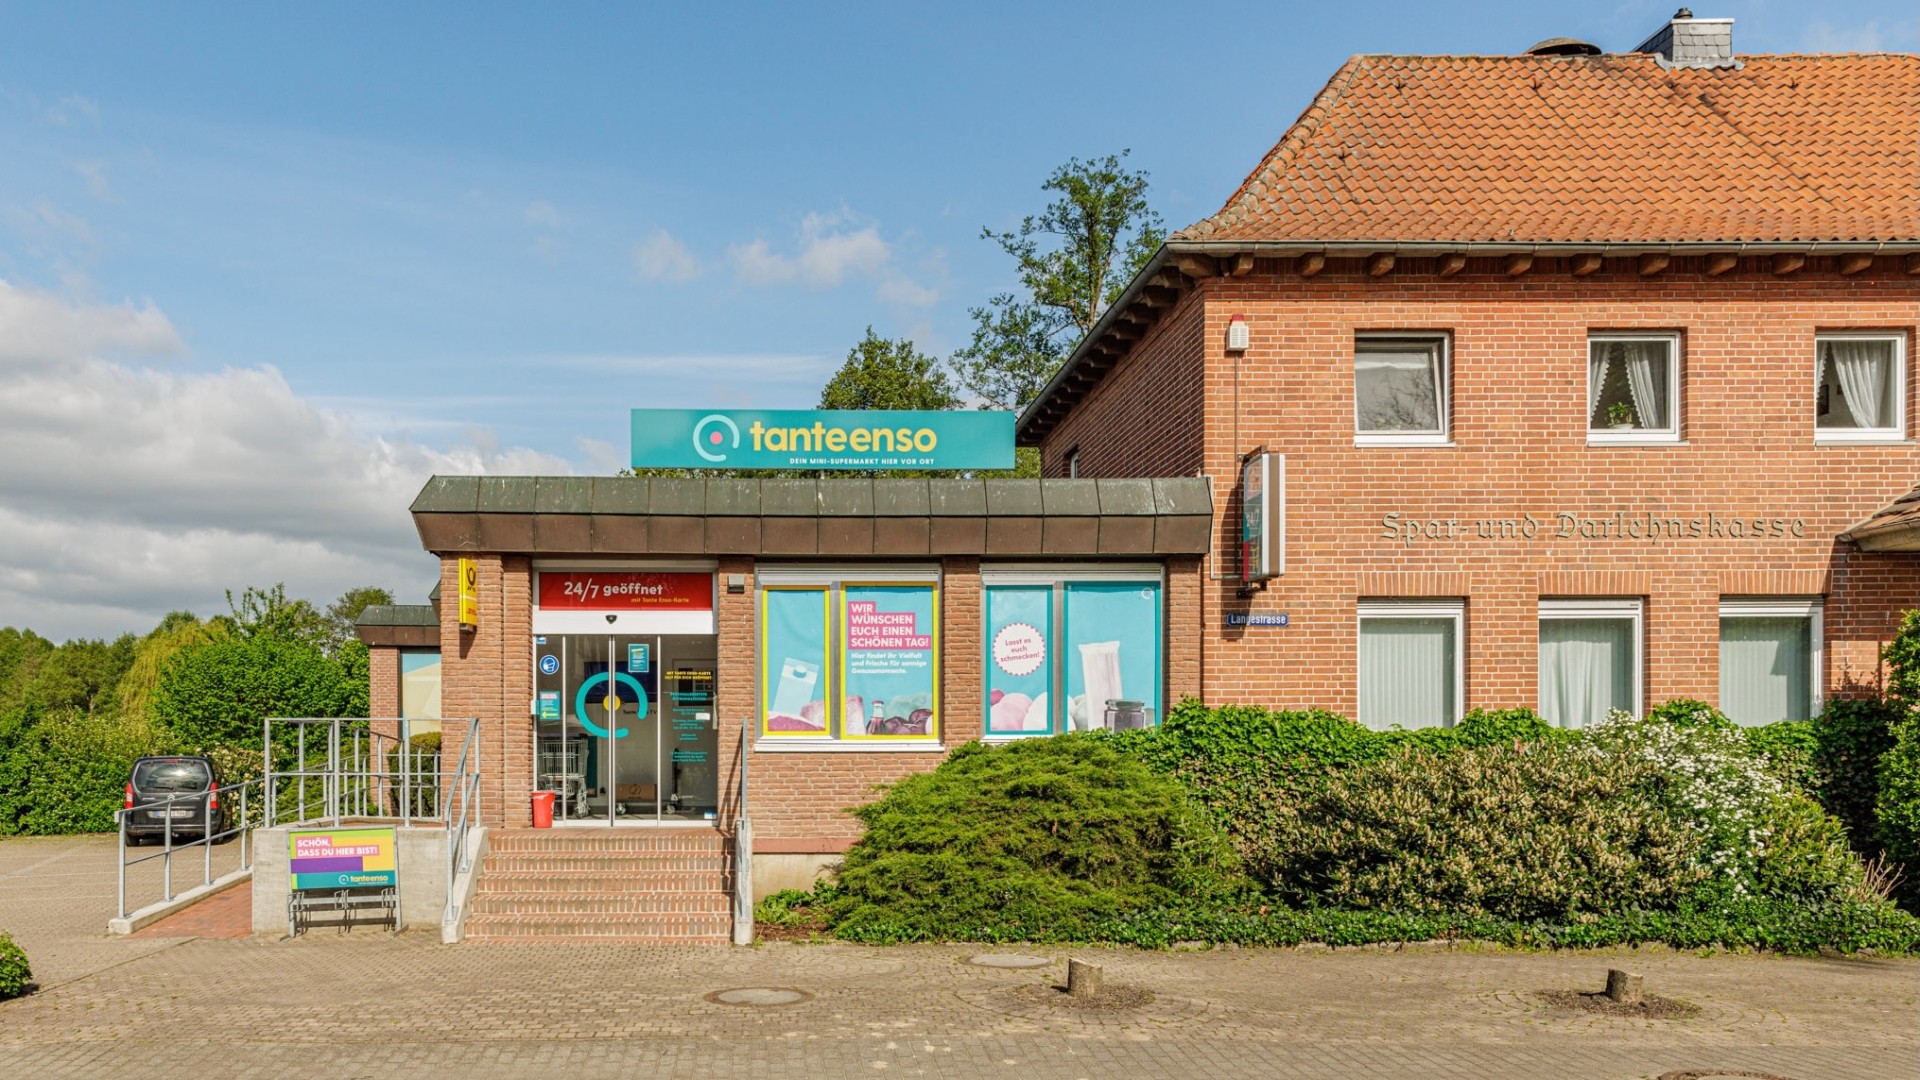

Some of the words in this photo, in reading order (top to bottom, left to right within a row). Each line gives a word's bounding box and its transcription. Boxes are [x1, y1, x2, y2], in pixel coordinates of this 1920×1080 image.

[750, 421, 937, 452] tanteenso
[1555, 511, 1807, 545] Darlehnskasse
[563, 578, 600, 602] 24/7
[603, 583, 663, 597] geöffnet
[851, 603, 873, 613] WIR
[851, 613, 913, 624] WÜNSCHEN
[1231, 614, 1286, 626] Langestrasse
[851, 626, 879, 636] EUCH
[882, 626, 913, 636] EINEN
[851, 636, 903, 647] SCHÖNEN
[905, 637, 929, 647] TAG!
[1011, 645, 1028, 653] euch
[1000, 651, 1040, 662] schmecken!
[297, 838, 331, 847] SCHÖN,
[297, 849, 320, 857] DASS
[322, 848, 334, 856] DU
[336, 847, 355, 855] HIER
[356, 846, 378, 855] BIST!
